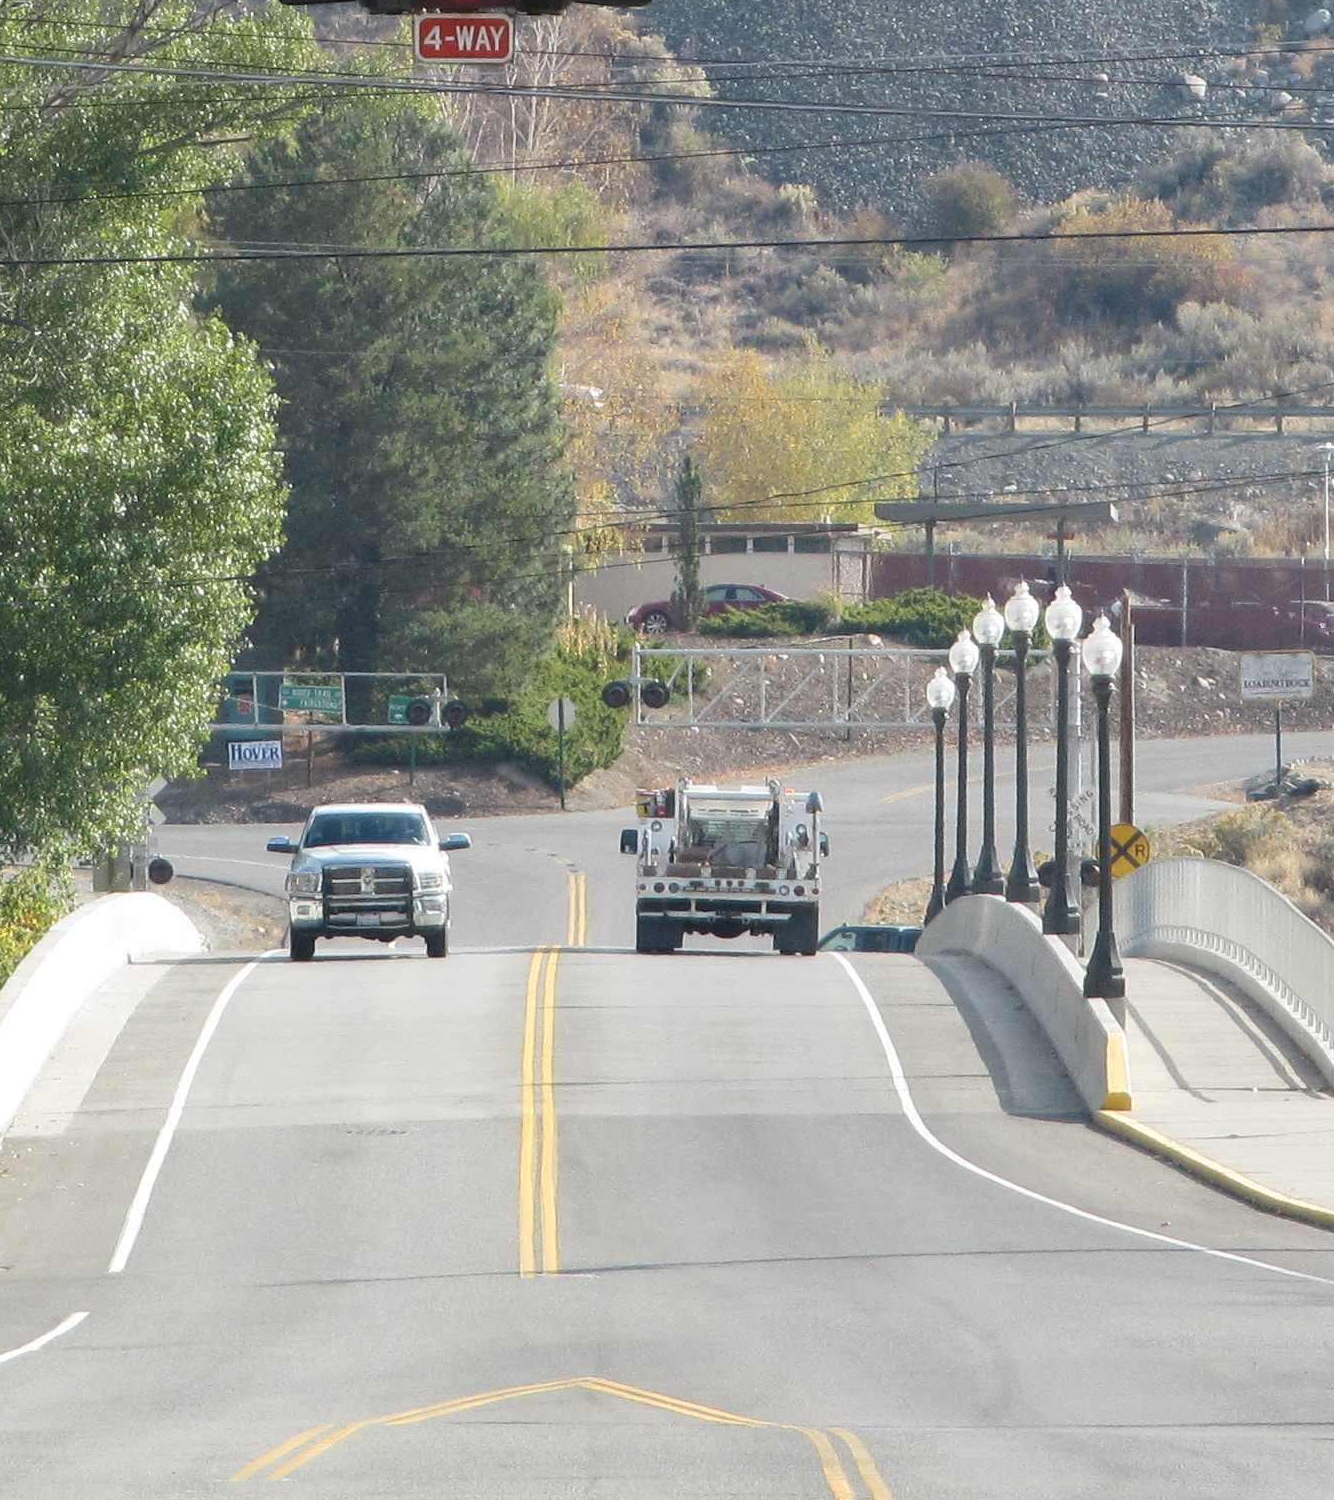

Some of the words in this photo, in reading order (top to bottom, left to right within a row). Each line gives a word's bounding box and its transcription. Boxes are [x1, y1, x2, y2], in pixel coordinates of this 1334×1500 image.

[424, 25, 505, 51] 4-WAY
[1285, 679, 1310, 687] DOCK
[231, 744, 280, 761] HOVER
[1073, 813, 1094, 836] ROAD
[1135, 844, 1146, 857] R
